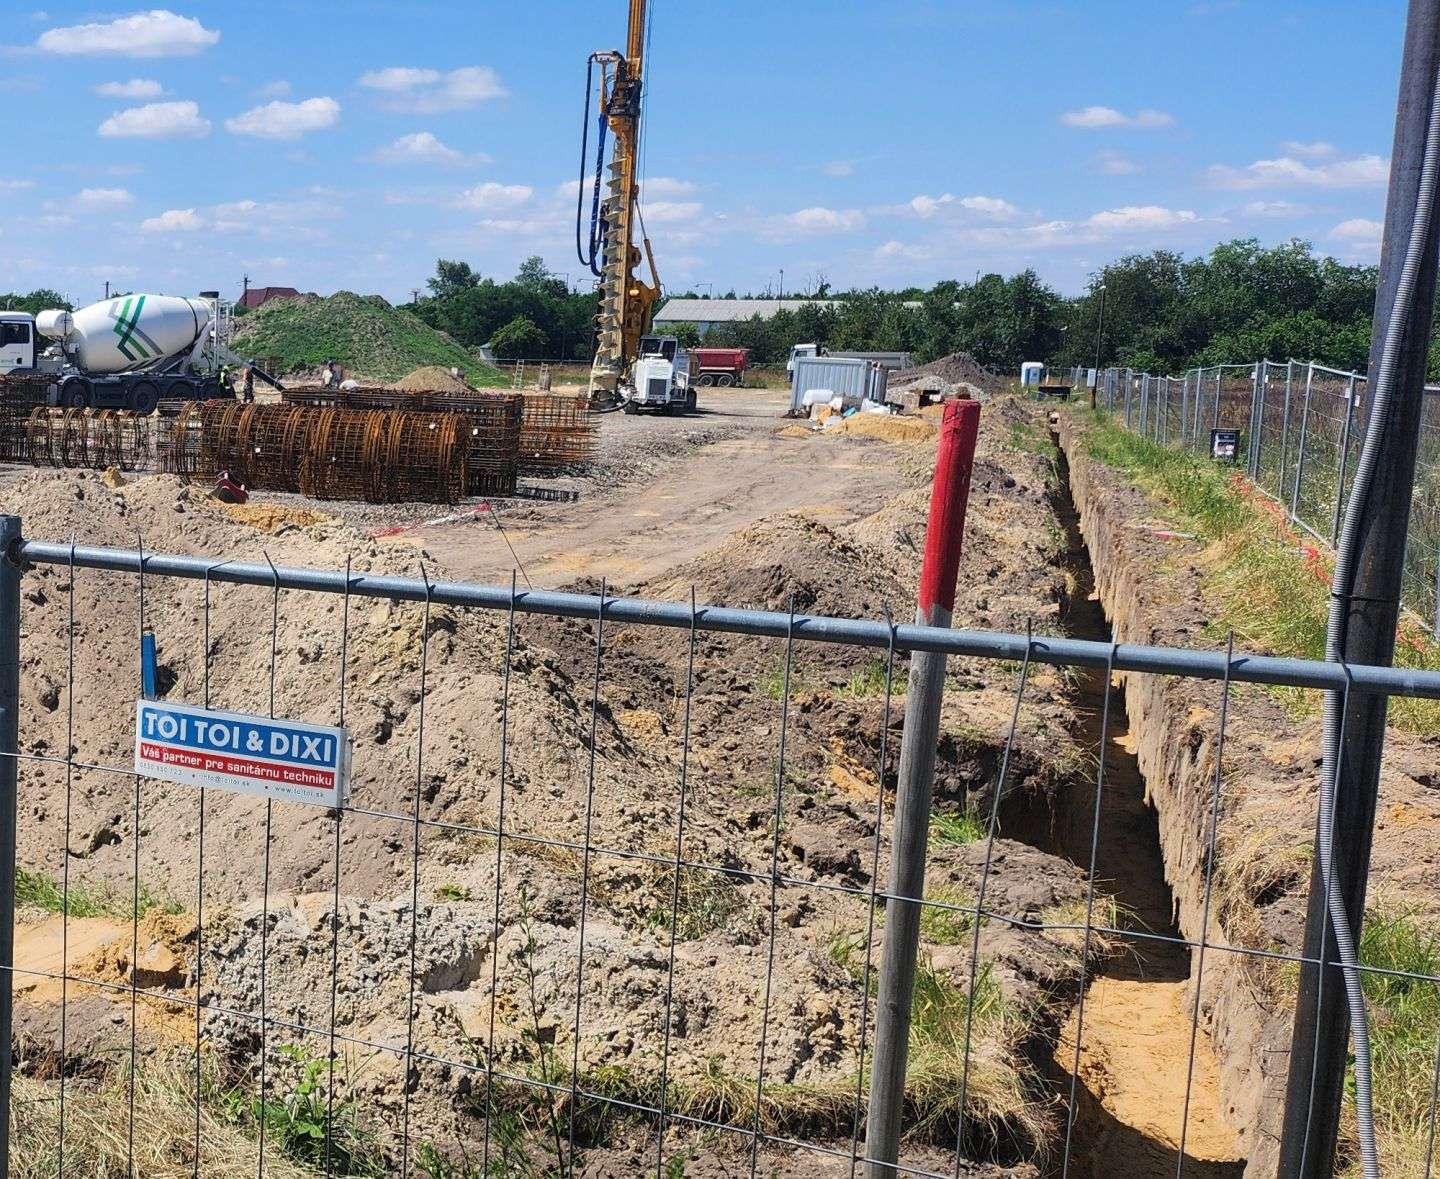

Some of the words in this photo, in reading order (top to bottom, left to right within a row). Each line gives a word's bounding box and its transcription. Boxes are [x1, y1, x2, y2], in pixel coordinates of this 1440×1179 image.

[145, 712, 187, 741] TOI
[194, 720, 240, 749] TOI
[246, 730, 264, 752] &
[270, 732, 331, 762] DIXI
[142, 744, 160, 758] Váš
[163, 751, 202, 766] partner
[205, 758, 224, 770] pre
[227, 762, 280, 778] sanitárnu
[283, 769, 333, 786] techniku
